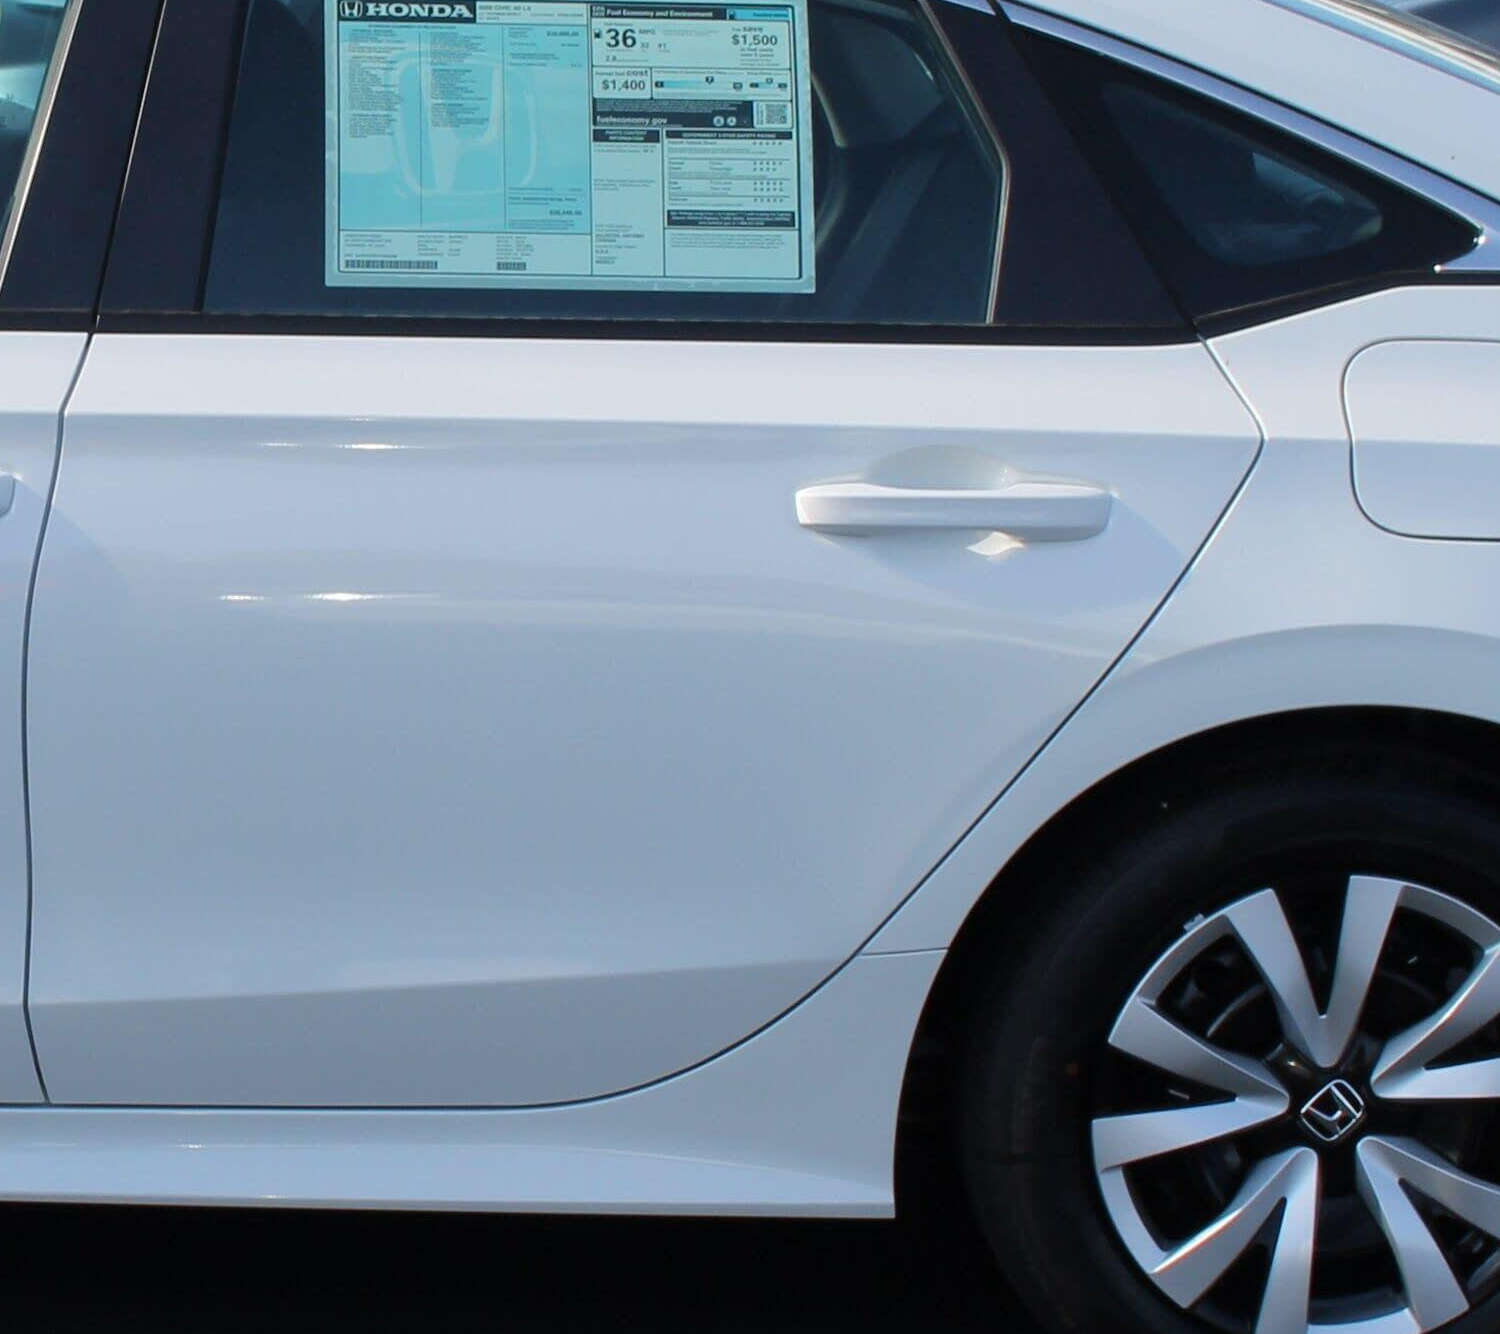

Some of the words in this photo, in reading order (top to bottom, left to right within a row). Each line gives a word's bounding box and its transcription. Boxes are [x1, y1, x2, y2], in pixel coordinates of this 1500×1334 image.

[367, 2, 473, 18] HONDA
[606, 8, 622, 17] Fuel
[623, 9, 653, 18] Economy
[670, 10, 713, 18] Environment
[606, 28, 636, 48] 36
[732, 34, 778, 47] $1,500
[626, 69, 649, 77] cost
[602, 79, 645, 91] $1,400
